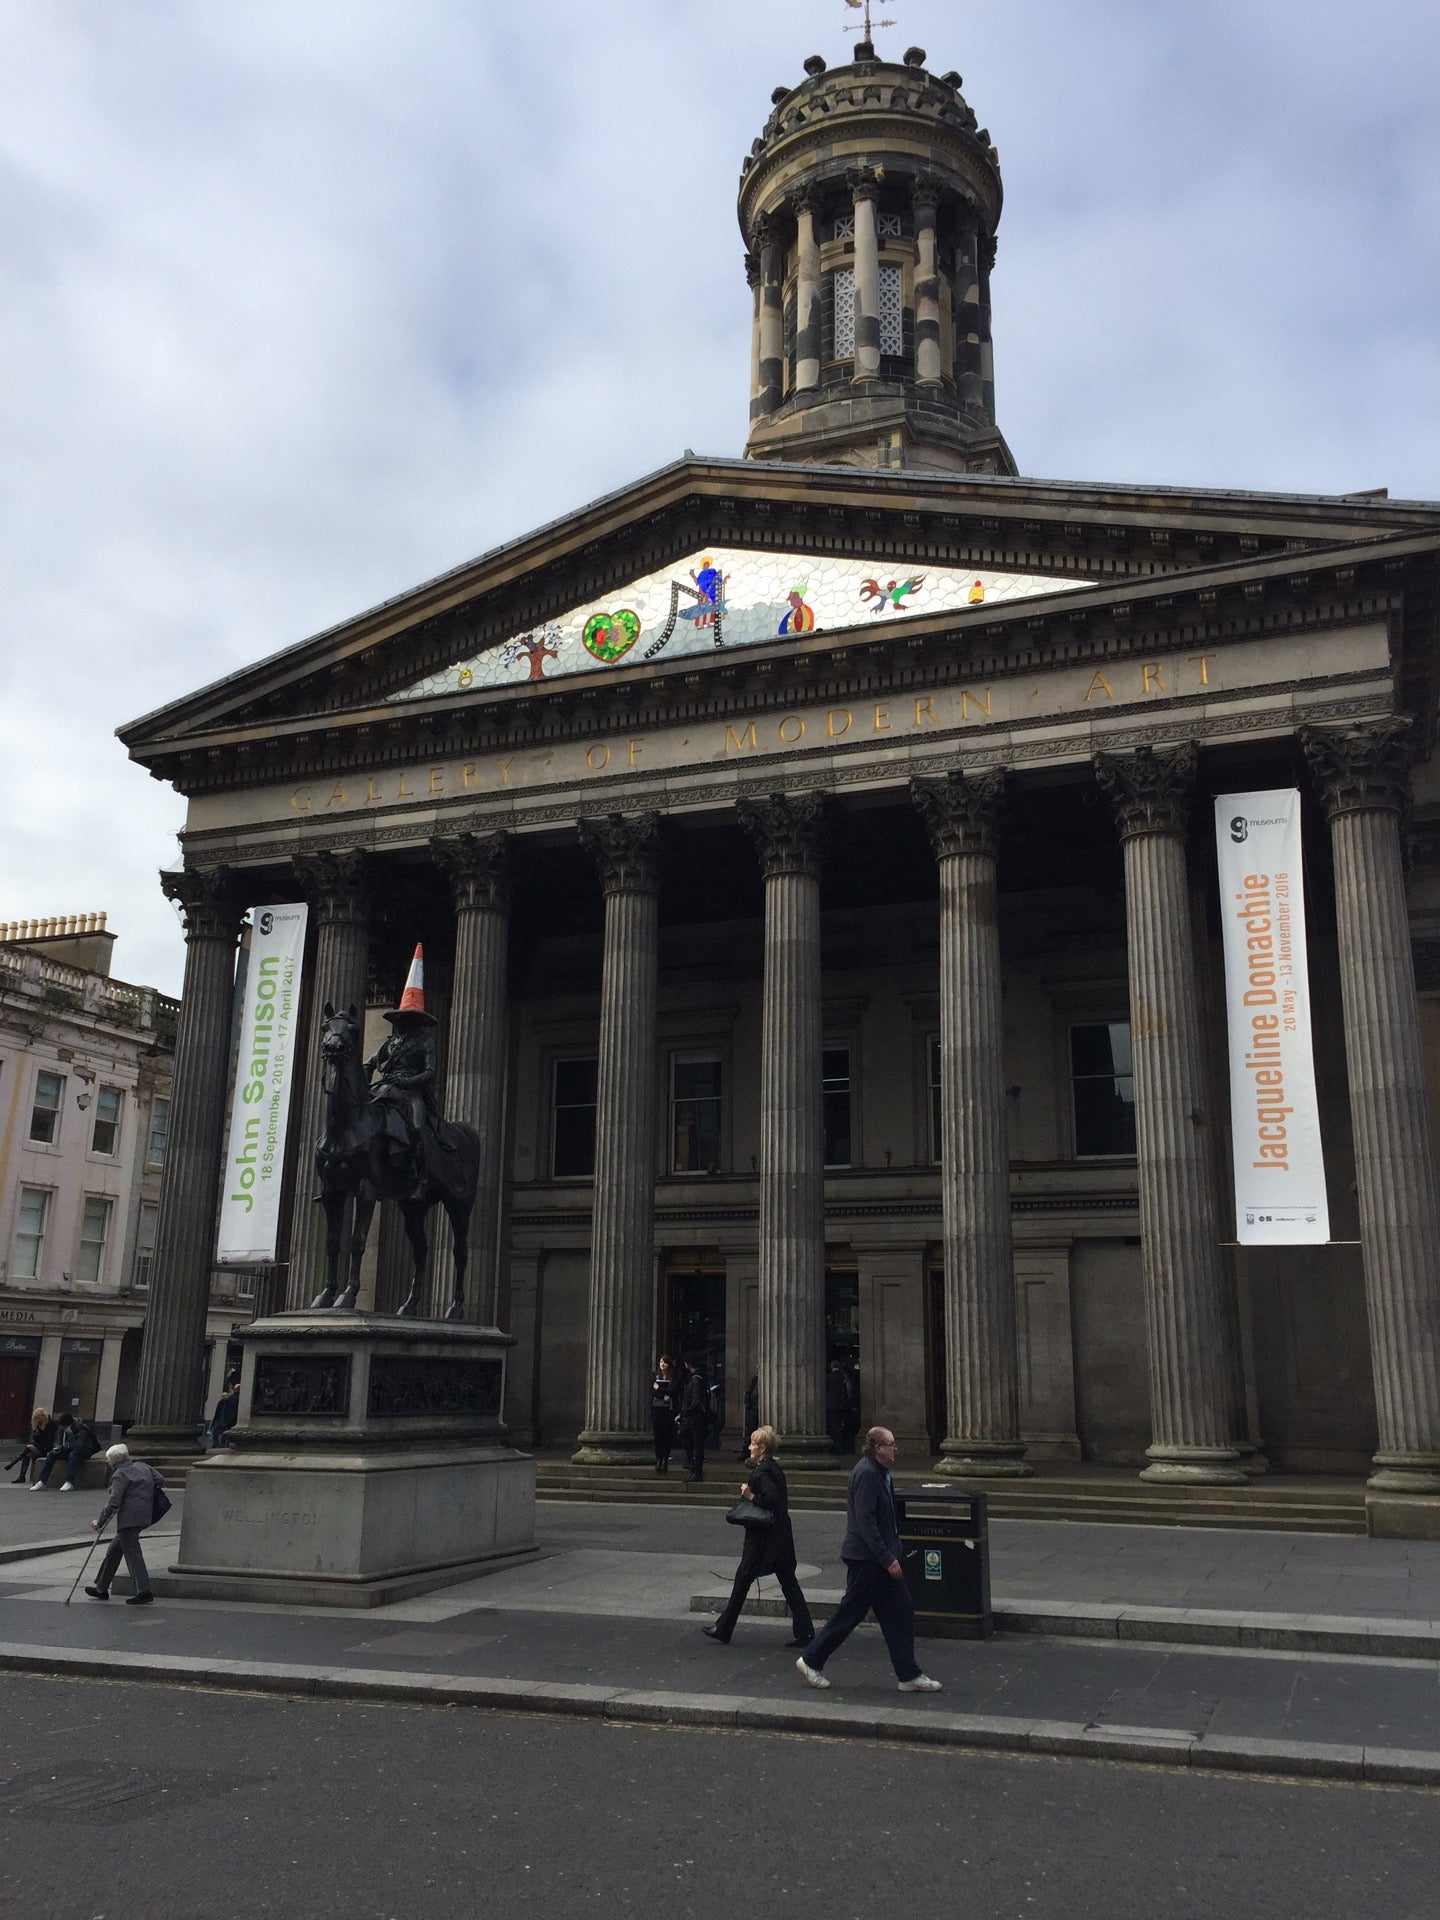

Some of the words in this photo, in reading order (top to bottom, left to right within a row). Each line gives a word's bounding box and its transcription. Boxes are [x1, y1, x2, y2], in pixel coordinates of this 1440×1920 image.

[291, 755, 516, 811] GALLERY
[586, 738, 646, 771] OF
[723, 687, 992, 753] MODERN
[1084, 655, 1218, 701] ART
[1250, 817, 1287, 827] museums
[1275, 872, 1289, 898] 2016
[1236, 873, 1277, 1006] Donachie
[1278, 901, 1292, 961] November
[283, 957, 295, 985] 2017
[1280, 965, 1292, 977] 13
[280, 990, 292, 1020] April
[1282, 990, 1296, 1013] May
[242, 956, 280, 1104] Samson
[278, 1025, 288, 1038] 17
[1284, 1017, 1296, 1032] 20
[272, 1054, 285, 1085] 2016
[1245, 1014, 1294, 1171] Jacqueline
[264, 1089, 281, 1161] September
[231, 1118, 261, 1213] John
[262, 1166, 273, 1181] 18
[0, 1311, 35, 1321] MEDIA
